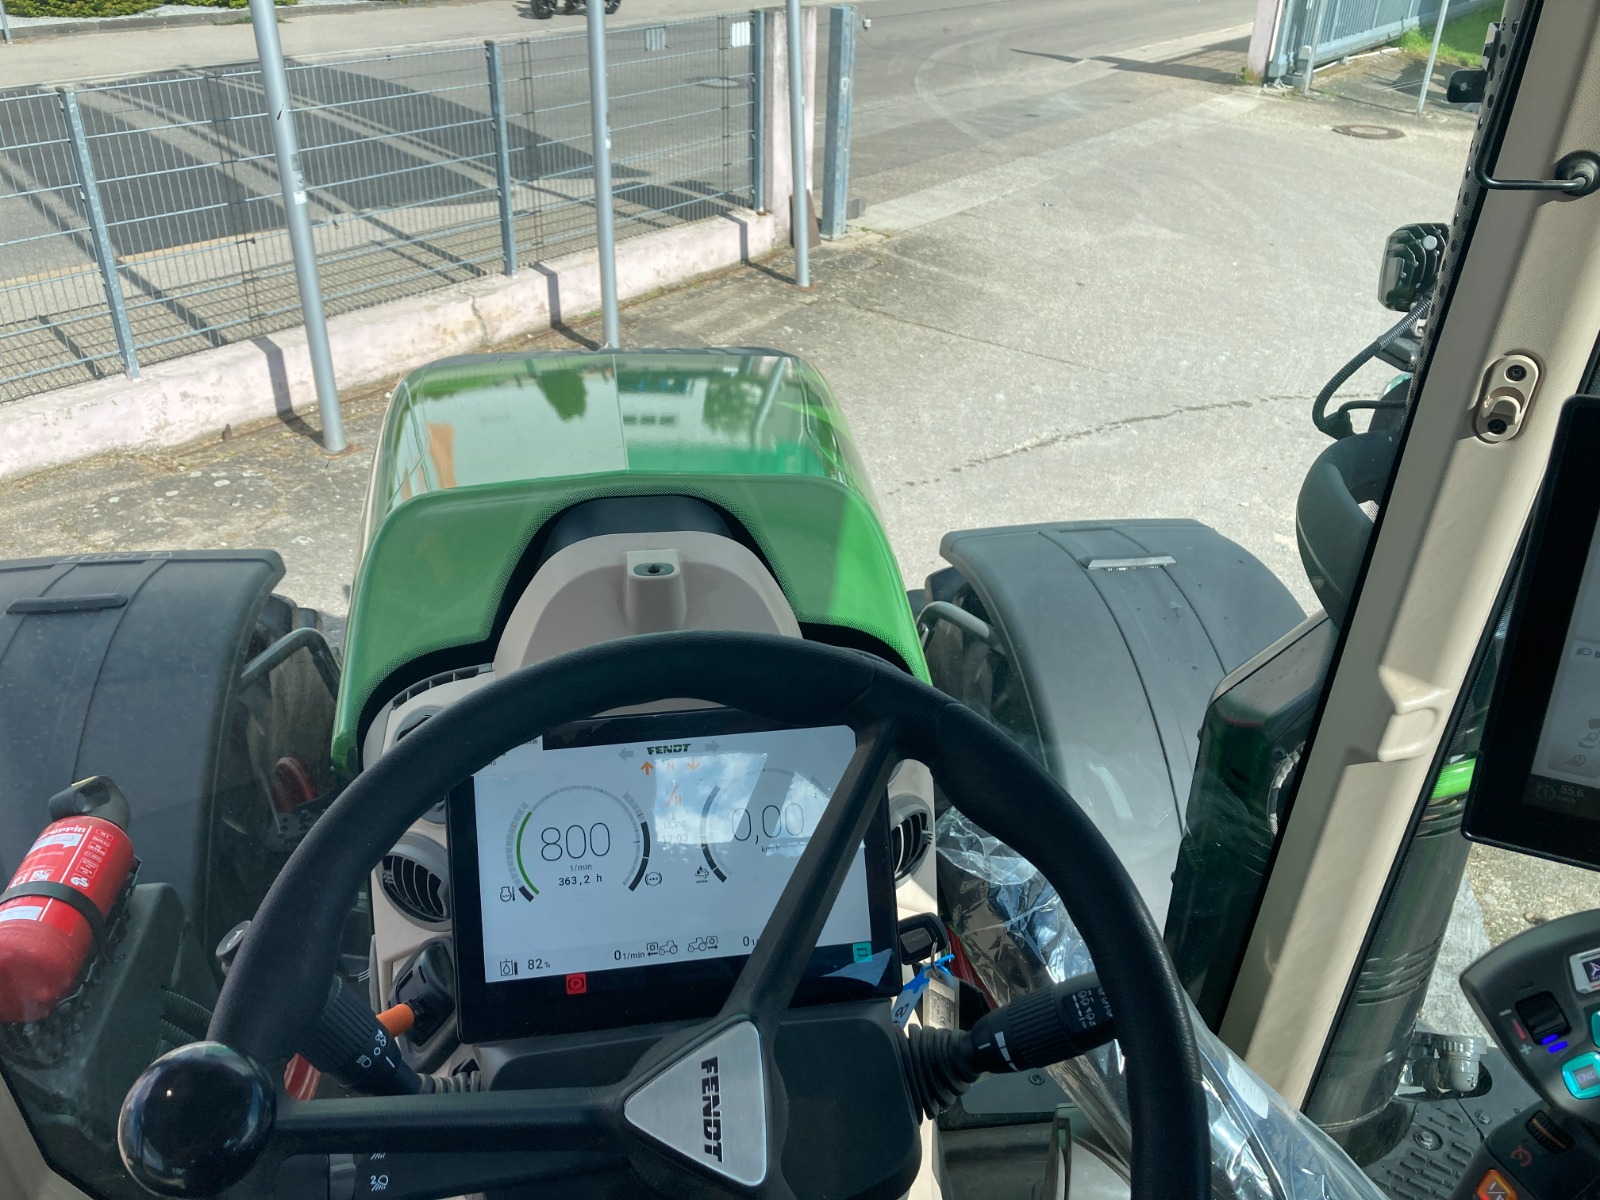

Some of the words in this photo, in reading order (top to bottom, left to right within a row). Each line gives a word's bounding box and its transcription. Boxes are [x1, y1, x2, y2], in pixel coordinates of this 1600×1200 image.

[647, 743, 691, 755] FENDT
[732, 802, 804, 845] 0,00
[541, 822, 611, 861] 800
[761, 845, 781, 853] km/h
[570, 863, 592, 872] 1/min
[558, 874, 590, 887] 363,2
[622, 951, 646, 961] 1/min
[701, 1056, 724, 1163] FENDT
